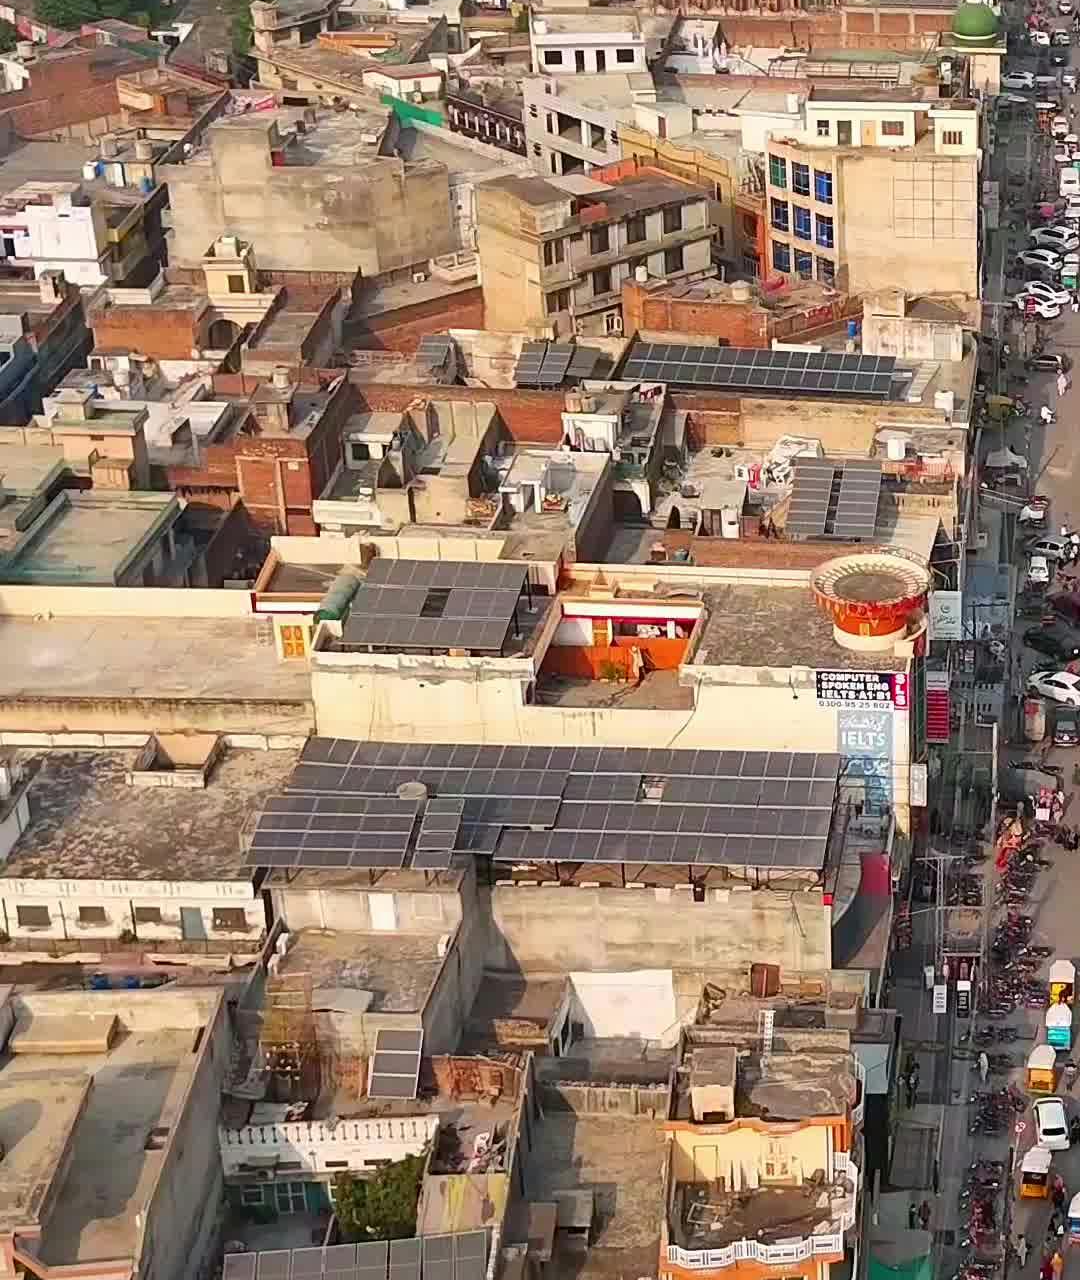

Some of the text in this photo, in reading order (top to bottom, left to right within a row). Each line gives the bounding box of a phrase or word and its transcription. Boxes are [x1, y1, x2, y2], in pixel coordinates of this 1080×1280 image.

[821, 673, 880, 682] COMPUTER
[821, 682, 865, 690] SPOKEN
[841, 731, 886, 746] IELTS
